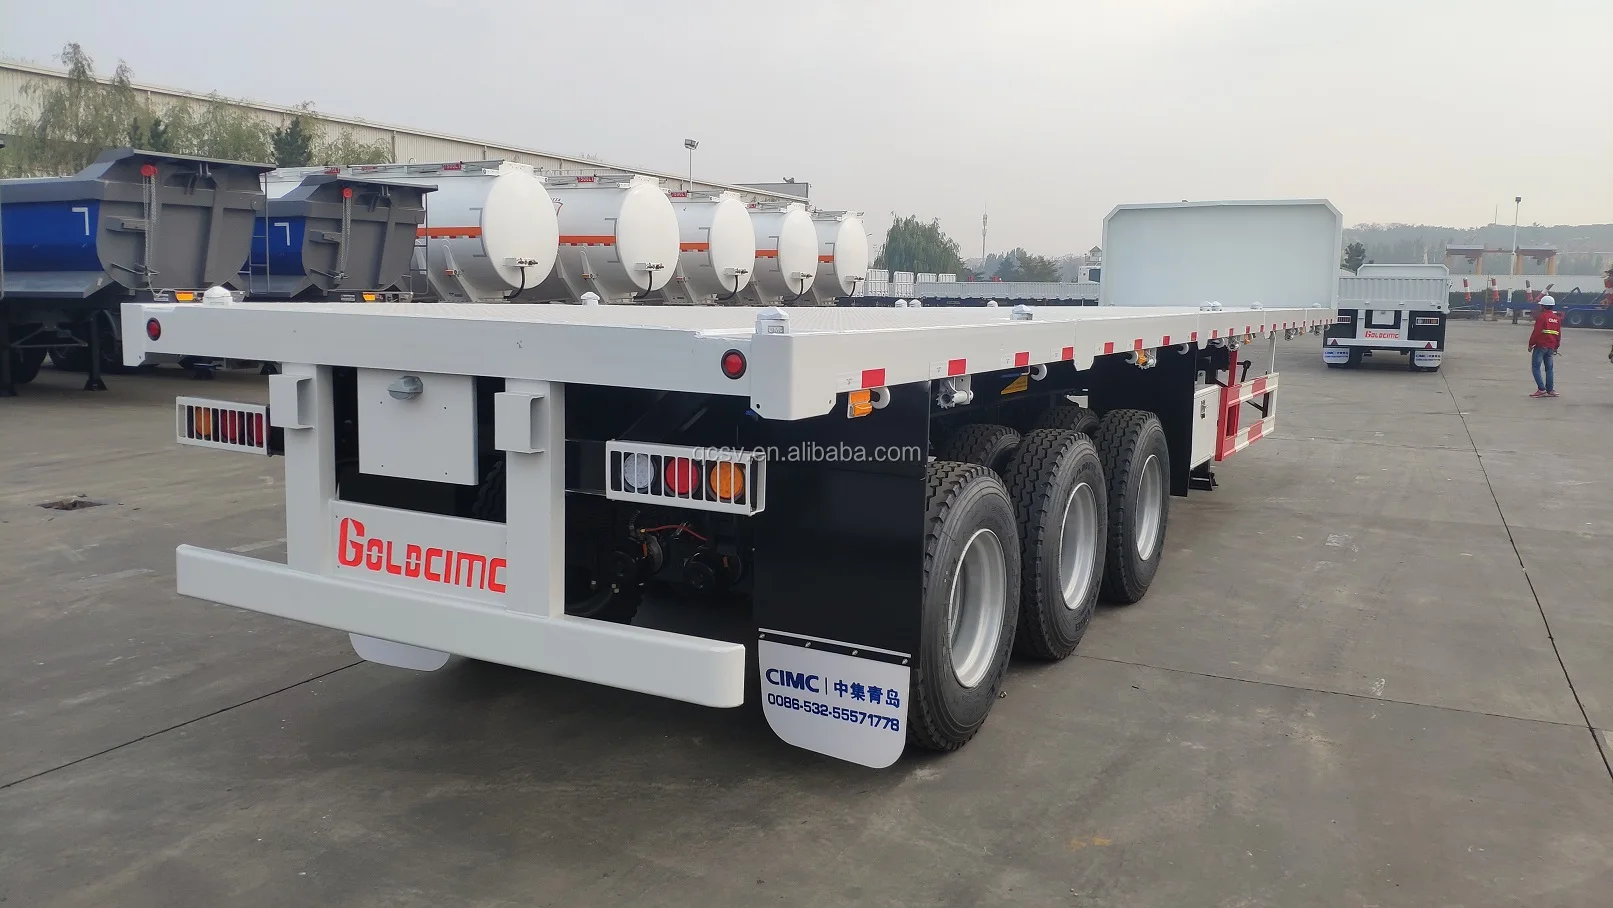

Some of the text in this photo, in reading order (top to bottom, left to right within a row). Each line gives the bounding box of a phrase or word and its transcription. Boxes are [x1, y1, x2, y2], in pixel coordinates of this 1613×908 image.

[765, 668, 820, 693] CIMC
[833, 680, 901, 709] 中集青岛
[767, 693, 900, 732] 0086-532-55571778
